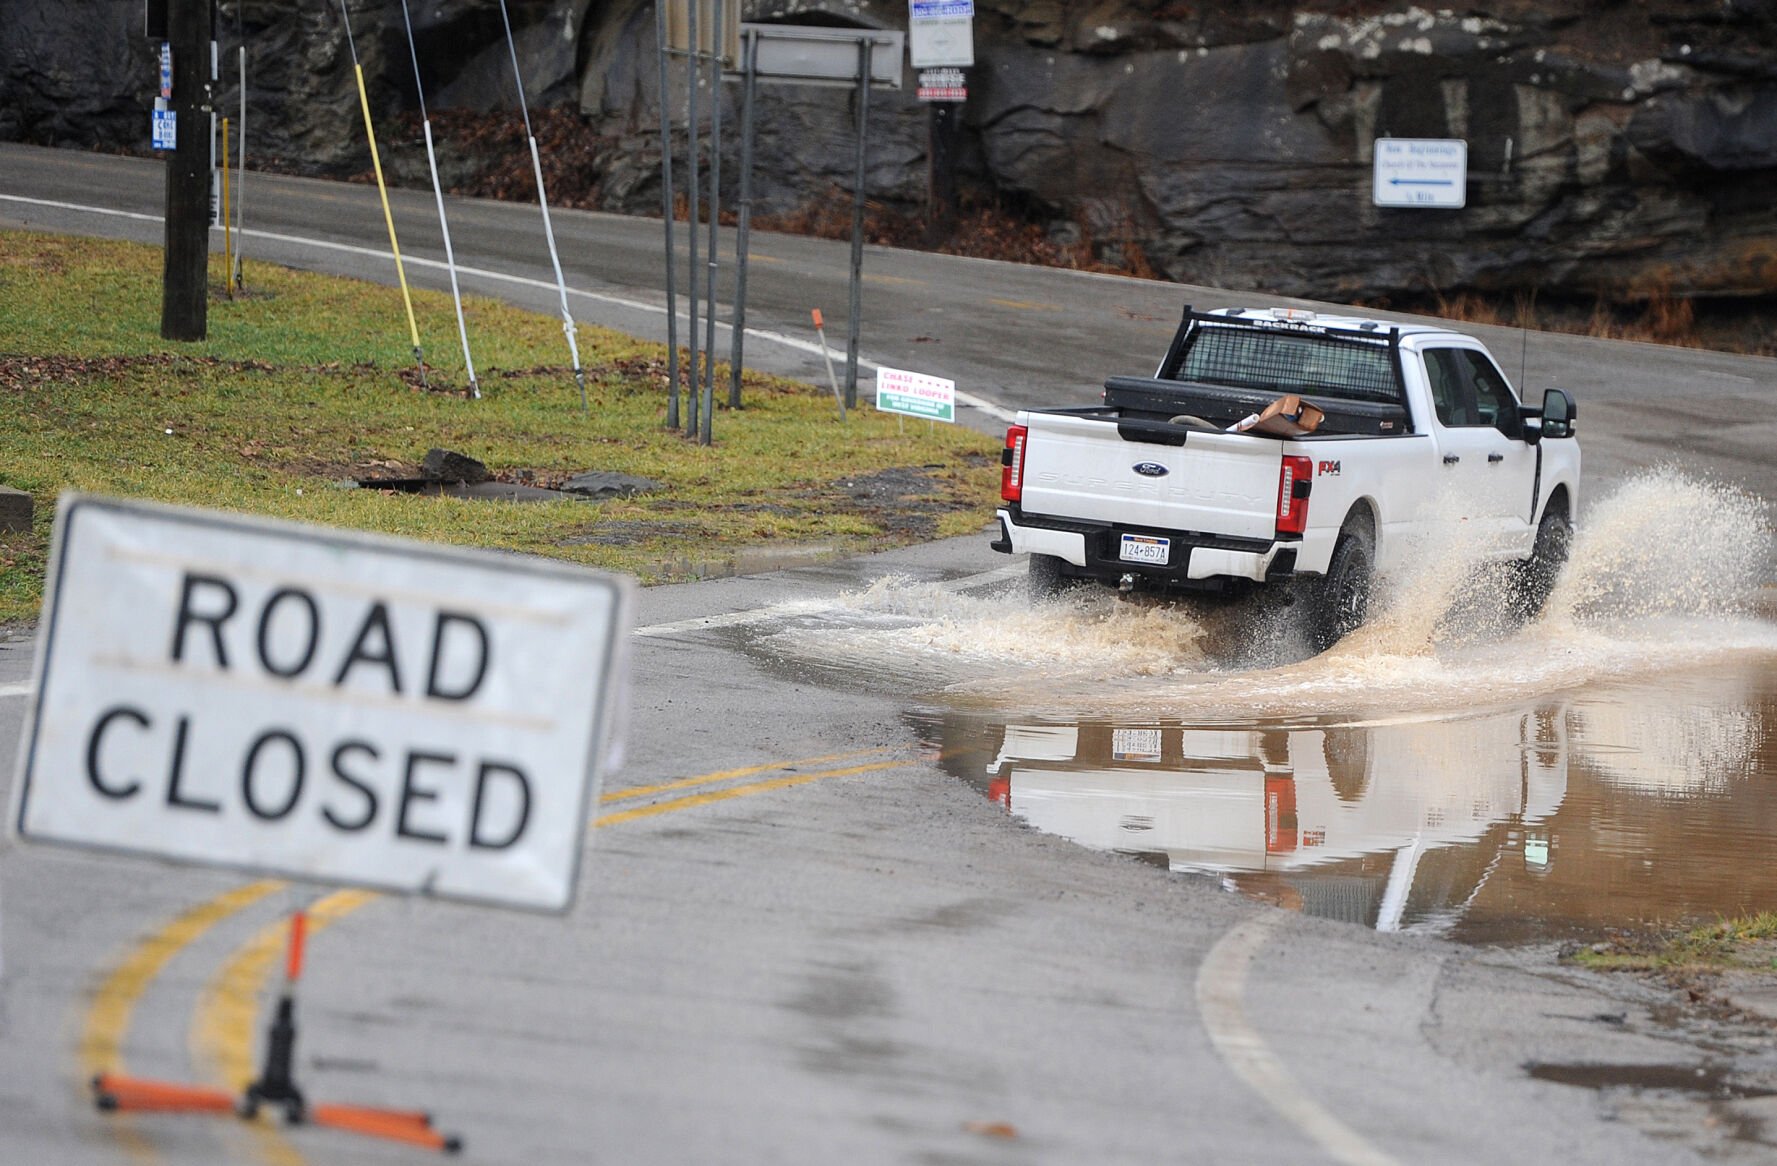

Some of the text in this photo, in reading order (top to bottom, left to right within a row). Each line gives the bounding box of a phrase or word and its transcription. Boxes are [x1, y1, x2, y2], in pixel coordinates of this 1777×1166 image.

[1253, 319, 1327, 334] BACKRACK
[883, 371, 913, 384] CHASE
[913, 386, 950, 400] LOOPER
[1140, 463, 1161, 475] Ford
[1318, 460, 1341, 476] FX4
[1038, 471, 1264, 505] SUPER DUTY
[171, 570, 493, 702] ROAD
[85, 704, 534, 853] CLOSED
